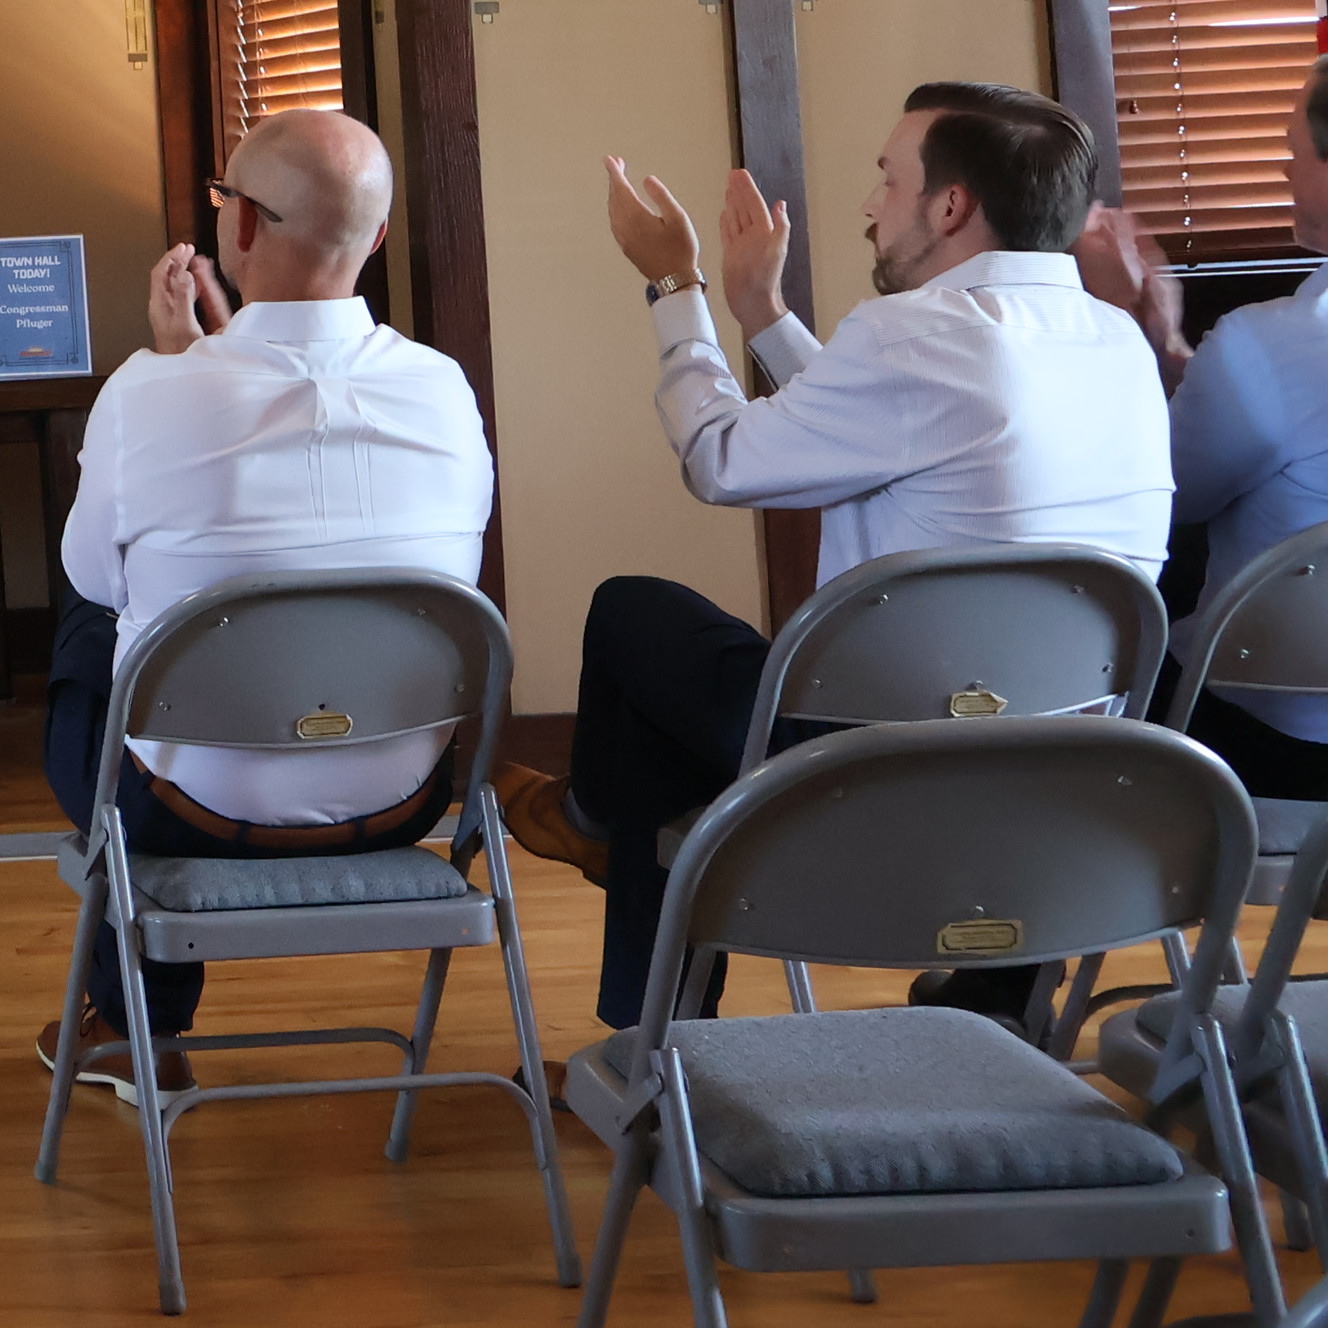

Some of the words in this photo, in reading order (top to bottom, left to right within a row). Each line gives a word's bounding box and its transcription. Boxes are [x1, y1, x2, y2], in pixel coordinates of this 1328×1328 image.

[0, 257, 32, 267] TOWN
[35, 255, 61, 266] HALL
[13, 269, 50, 279] TODAY!
[8, 284, 55, 294] Welcome
[0, 305, 69, 316] Congressman
[16, 319, 53, 329] Pfluger
